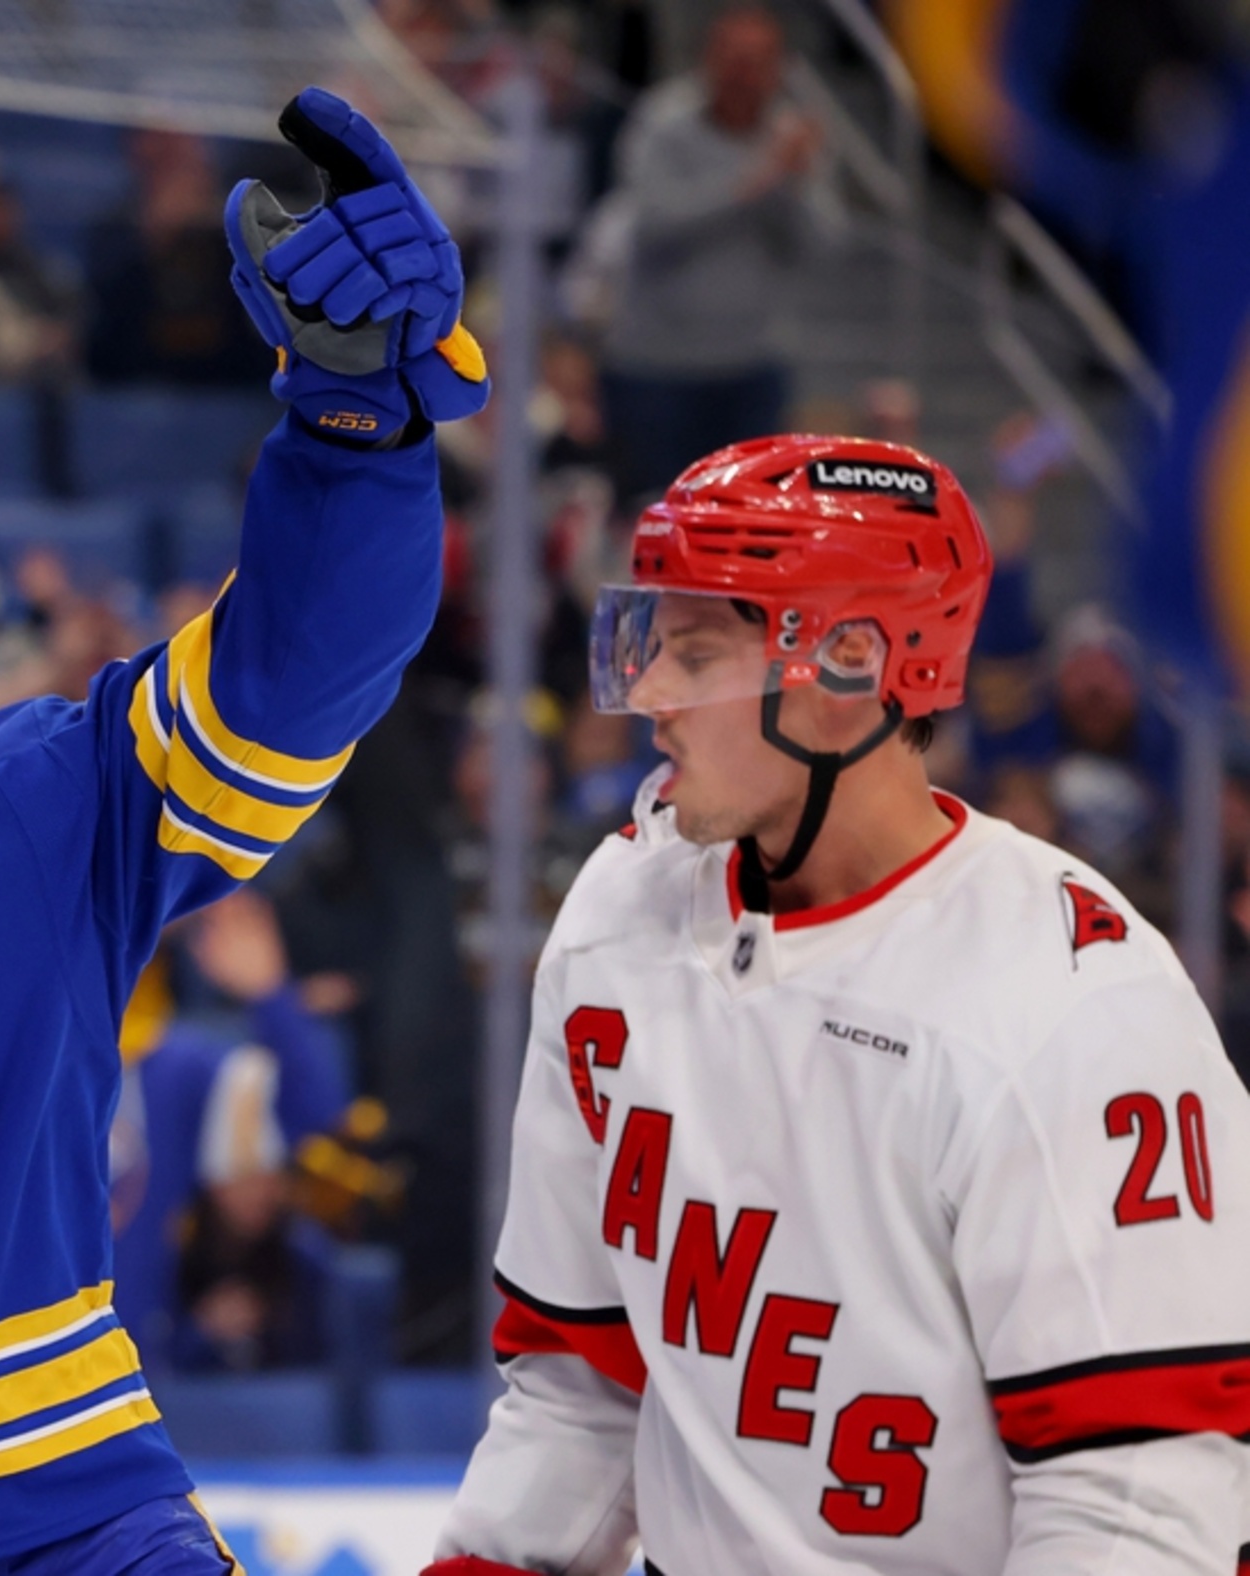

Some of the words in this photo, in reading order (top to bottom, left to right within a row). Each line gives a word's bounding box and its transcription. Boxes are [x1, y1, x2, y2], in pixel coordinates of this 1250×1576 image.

[318, 415, 377, 430] CCM
[816, 462, 928, 493] Lenovo
[1104, 1090, 1214, 1228] 20
[564, 1005, 938, 1537] CANES
